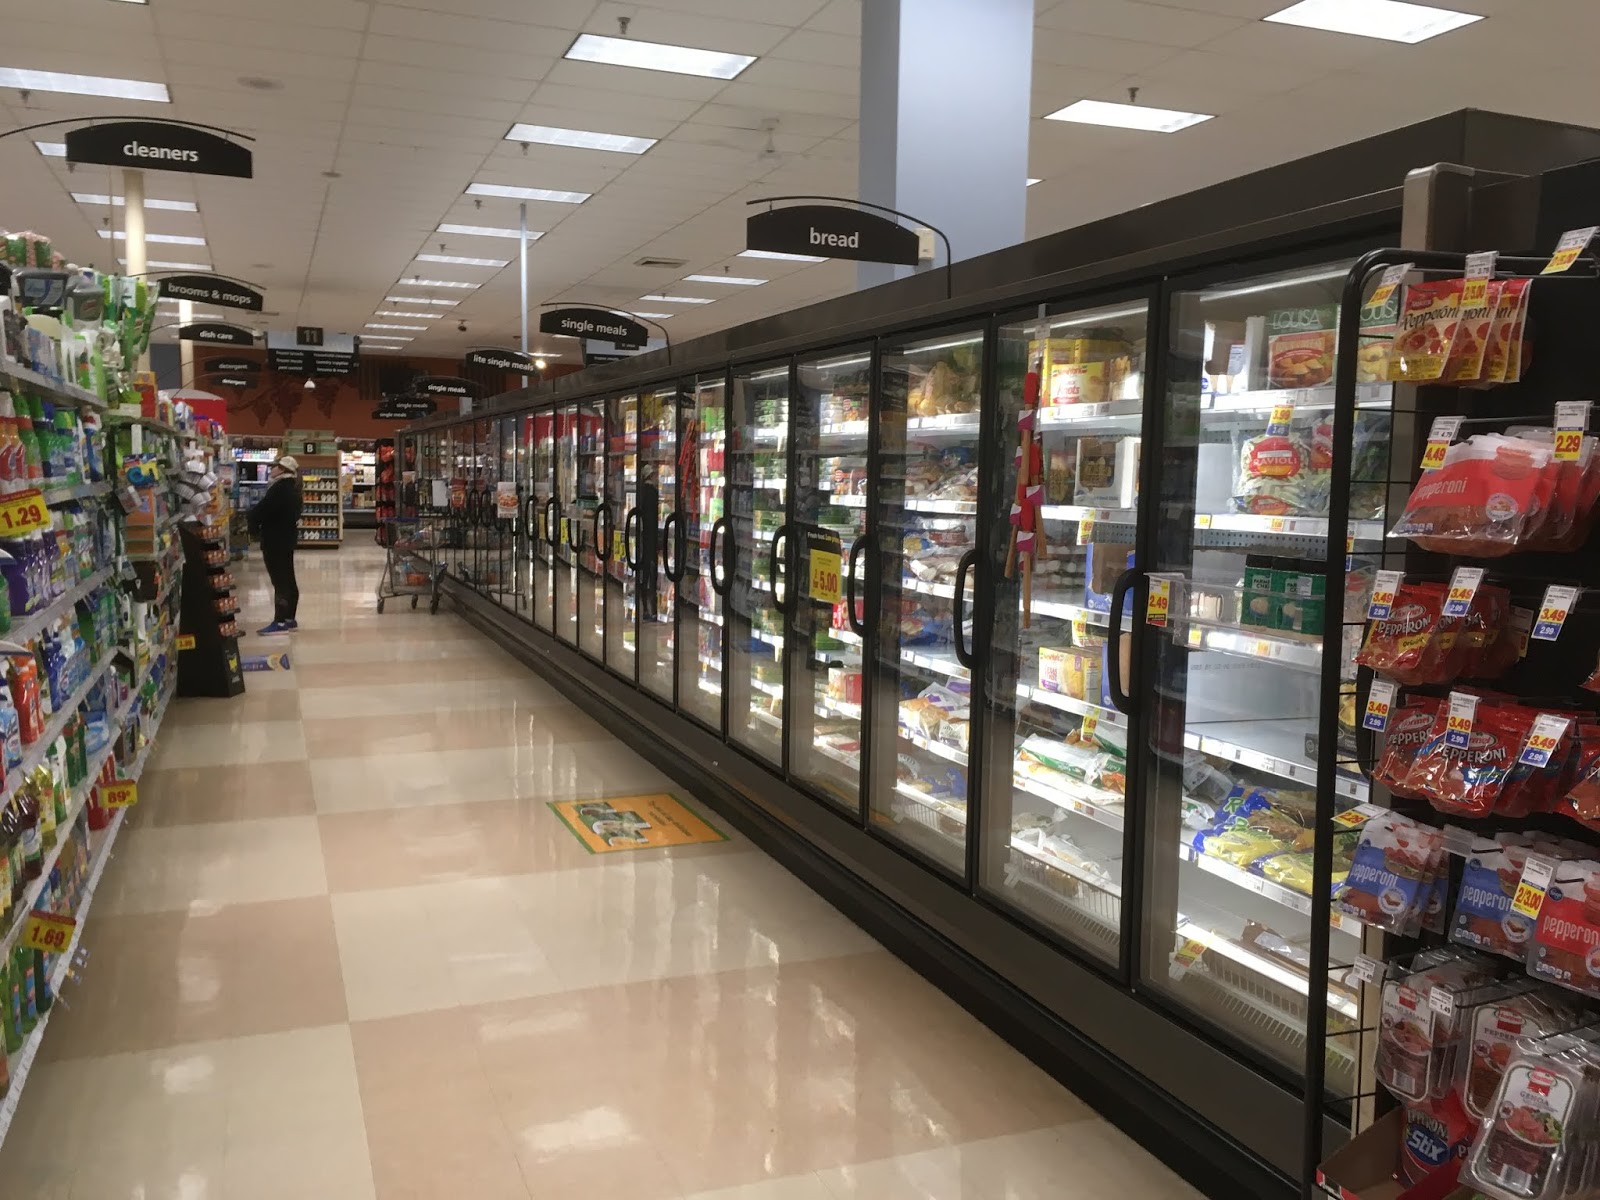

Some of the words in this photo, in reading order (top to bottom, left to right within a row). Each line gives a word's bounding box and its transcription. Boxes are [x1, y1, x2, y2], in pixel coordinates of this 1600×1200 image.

[123, 140, 199, 163] cleaners
[809, 227, 859, 248] bread
[167, 281, 209, 299] brooms
[211, 289, 219, 300] &
[222, 292, 251, 306] mops
[561, 317, 594, 333] single
[597, 323, 628, 337] meals
[199, 330, 216, 339] dish
[304, 329, 318, 344] 11
[218, 362, 248, 371] detergent
[473, 354, 486, 363] lite
[488, 356, 511, 369] single
[512, 361, 534, 372] meals
[428, 384, 446, 393] single
[307, 444, 313, 453] B
[1556, 435, 1581, 453] 2.29
[1424, 447, 1446, 462] 4.49
[1252, 456, 1298, 468] RAVIOLI
[1414, 476, 1469, 501] pepperoni
[2, 504, 42, 529] 1.29
[820, 570, 838, 593] 5.00
[1372, 592, 1393, 604] 3.49
[1450, 588, 1474, 599] 3.49
[1149, 595, 1168, 609] 2.49
[1449, 604, 1463, 612] 2.99
[1373, 608, 1386, 616] 2.99
[1539, 608, 1565, 621] 3.49
[1539, 626, 1554, 635] 2.99
[1367, 701, 1389, 714] 3.49
[1368, 717, 1382, 726] 2.99
[1448, 716, 1471, 730] 3.49
[1450, 734, 1465, 744] 2.99
[1529, 735, 1557, 749] 3.49
[1527, 751, 1544, 762] 2.99
[1350, 862, 1400, 888] pepperoni
[1462, 884, 1514, 913] pepperon
[1515, 886, 1542, 912] 2/3.00
[1542, 915, 1600, 945] pepperon
[1439, 1003, 1451, 1015] 1.49
[1407, 1130, 1445, 1162] Stix
